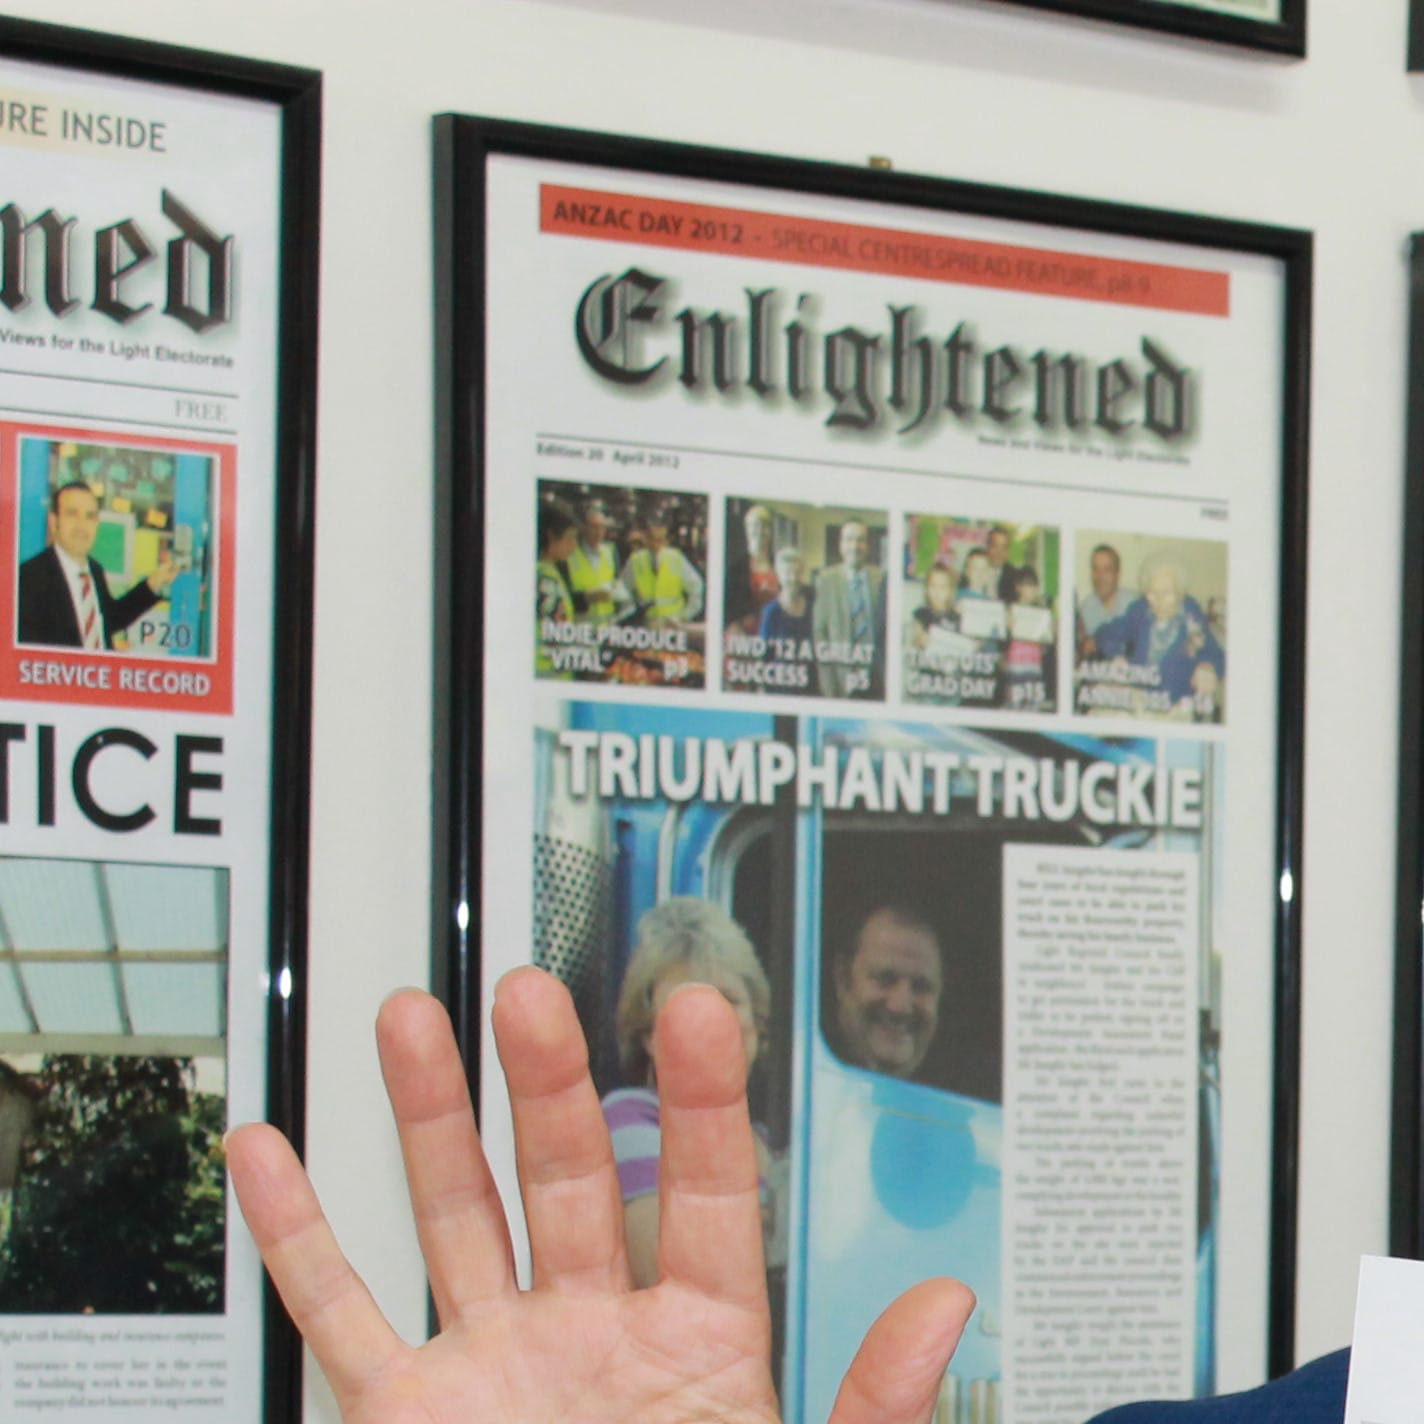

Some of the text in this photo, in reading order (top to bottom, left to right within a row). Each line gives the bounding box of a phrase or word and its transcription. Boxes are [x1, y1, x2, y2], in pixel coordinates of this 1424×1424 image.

[62, 110, 167, 152] INSIDE
[553, 201, 631, 227] ANZAC
[639, 211, 683, 235] DAY
[690, 219, 744, 243] 2012
[772, 229, 852, 259] SPECIAL
[859, 238, 1014, 280] CENTRESPREAD
[0, 186, 236, 333] ned
[0, 329, 234, 368] Views for the Light Electorate
[574, 266, 1190, 440] Enlightened
[175, 400, 228, 423] FREE
[537, 442, 584, 458] Edition
[613, 450, 645, 467] April
[140, 621, 192, 649] P20
[542, 622, 688, 652] INDIE PRODUCE
[798, 641, 813, 660] A
[817, 642, 874, 663] GREAT
[19, 659, 211, 697] SERVICE RECORD
[727, 660, 809, 687] SUCCESS
[907, 672, 997, 699] GRAD DAY
[1079, 660, 1161, 686] AMAZING
[560, 730, 1201, 829] TRIUMPHANT TRUCKIE
